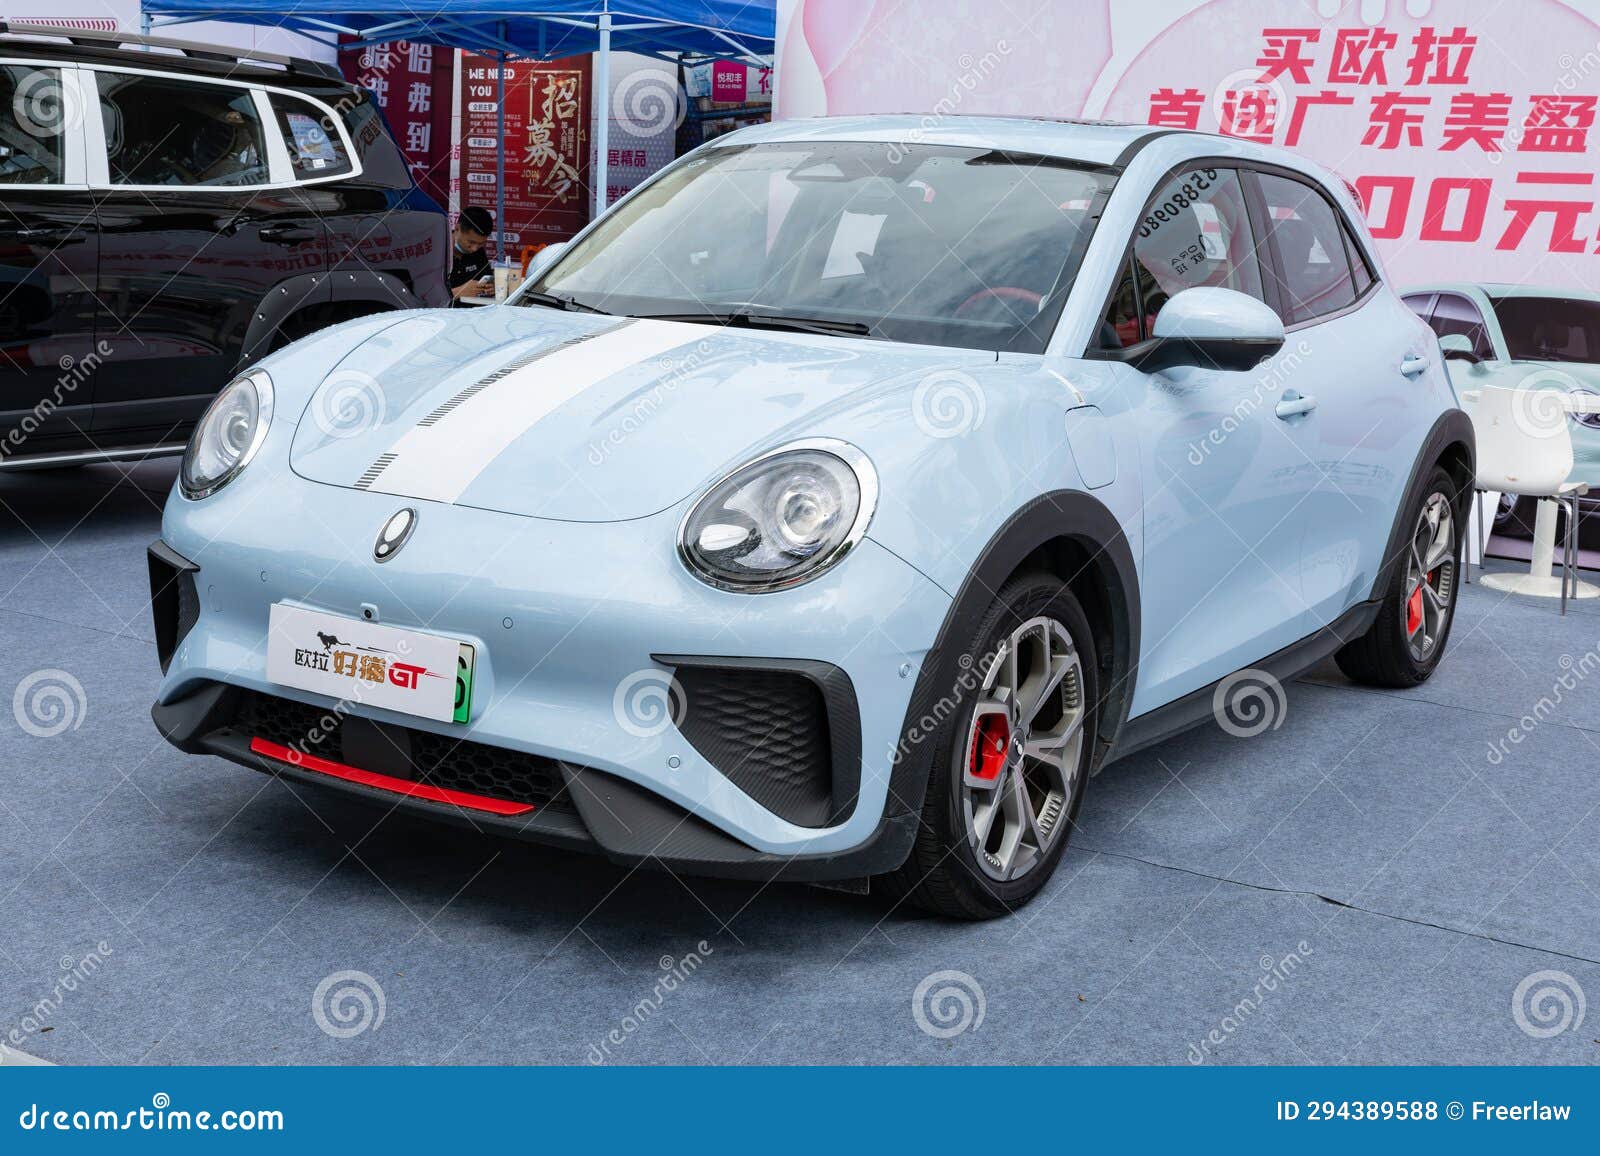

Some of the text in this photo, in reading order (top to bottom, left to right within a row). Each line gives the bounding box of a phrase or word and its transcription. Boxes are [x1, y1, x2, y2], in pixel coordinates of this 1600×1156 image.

[469, 68, 485, 80] WE
[1255, 27, 1478, 86] 买欧拉
[469, 85, 492, 97] YOU
[522, 74, 580, 204] 招募令
[1147, 88, 1599, 153] 首选广东美盈
[594, 149, 646, 168] 居精品
[1355, 172, 1600, 254] 00元
[388, 662, 428, 690] GT
